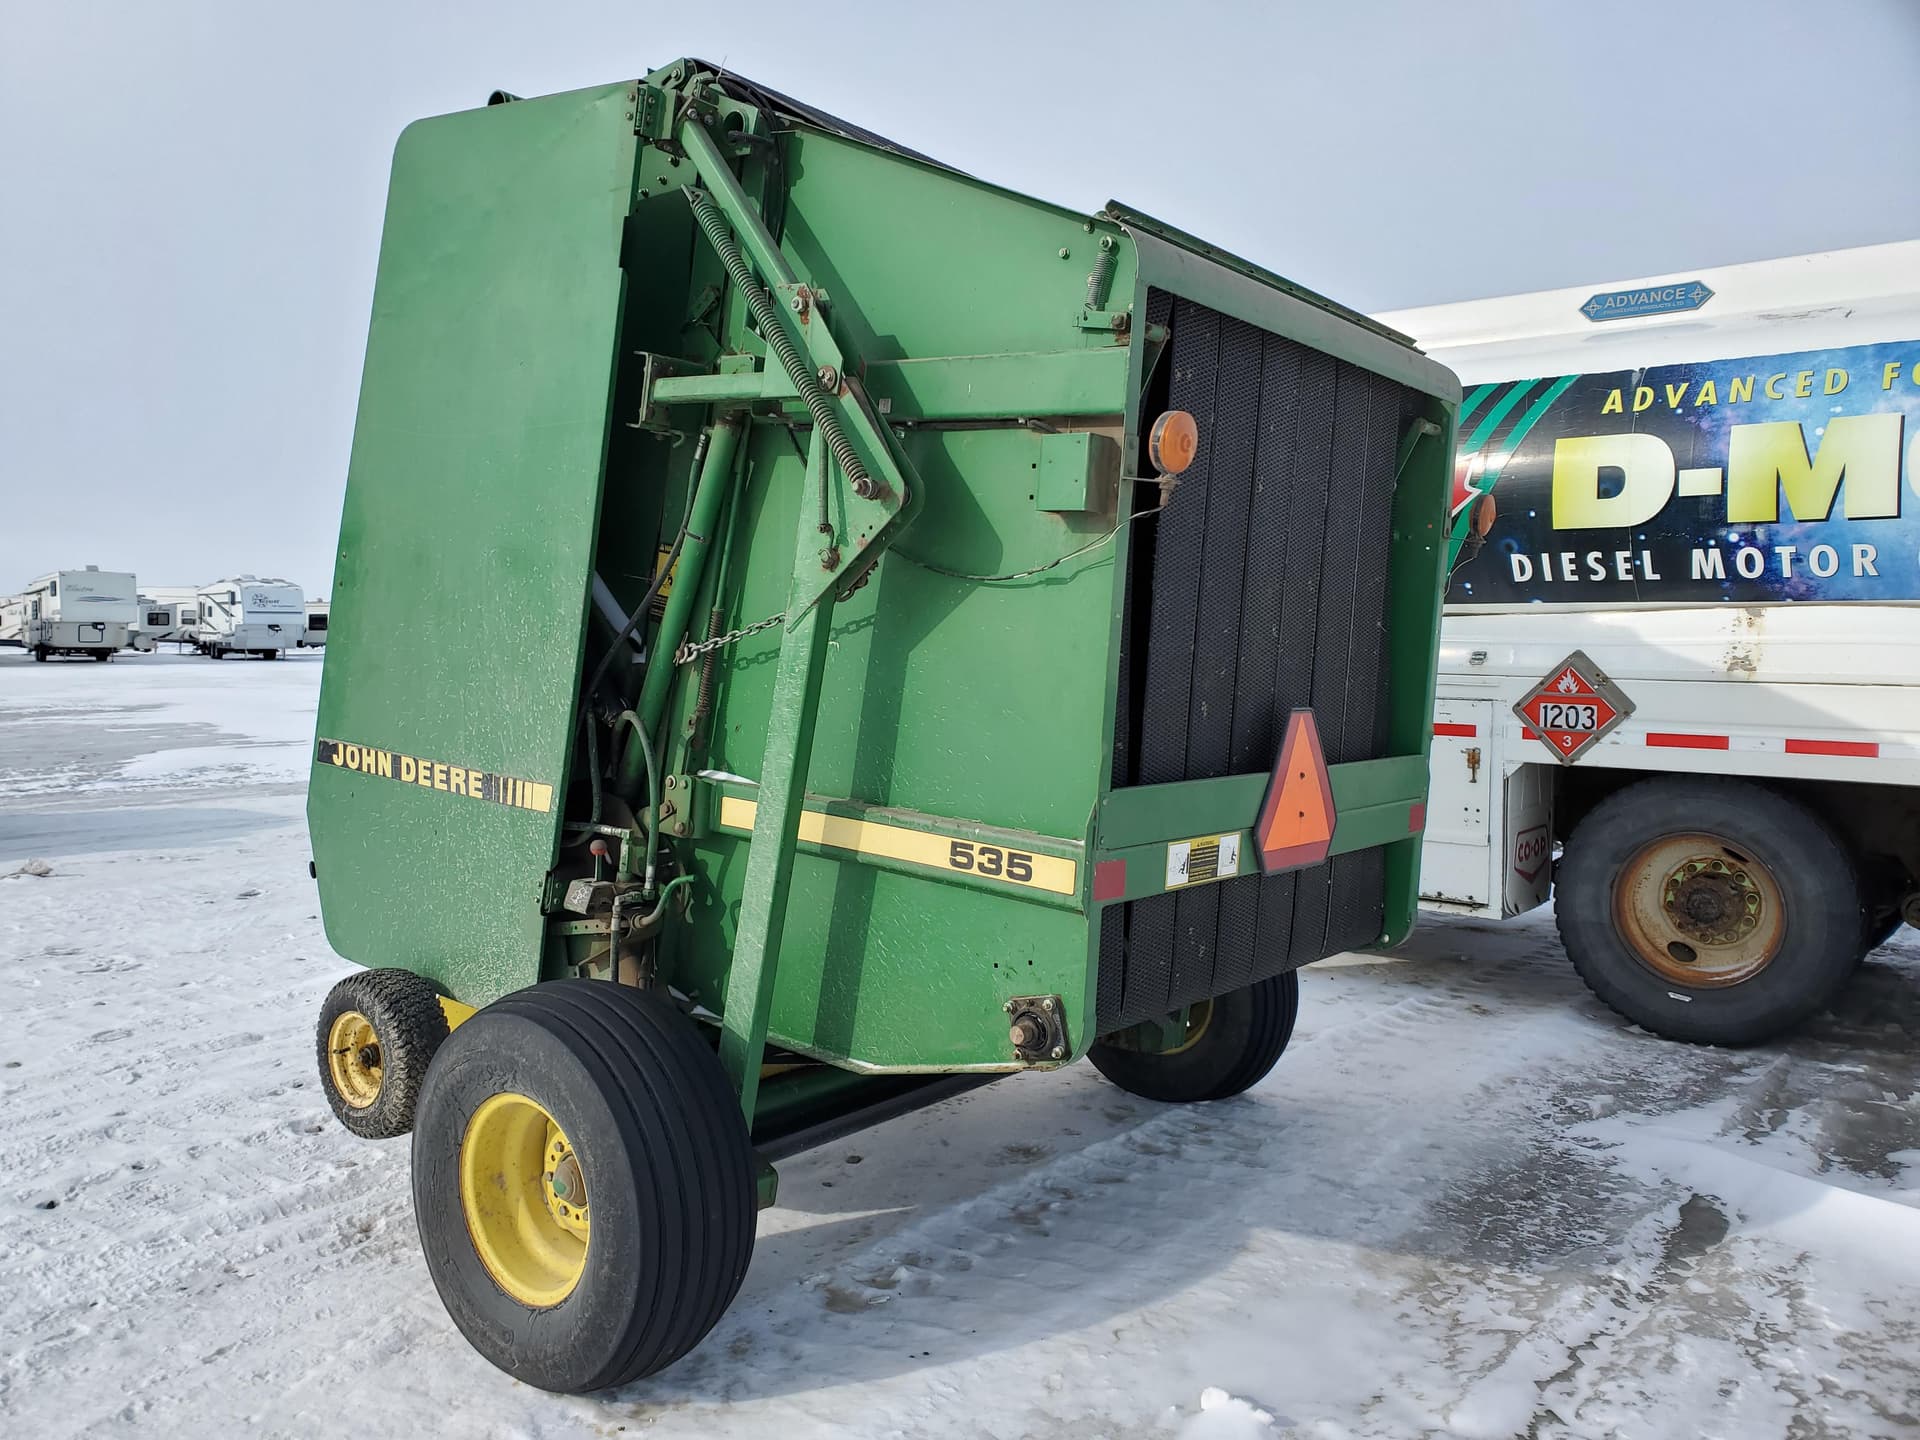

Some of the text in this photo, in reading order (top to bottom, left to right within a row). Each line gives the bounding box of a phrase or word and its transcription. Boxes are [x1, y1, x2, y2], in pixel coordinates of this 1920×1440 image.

[1604, 287, 1686, 309] ADVANCE
[1601, 368, 1850, 415] ADVANCED
[1552, 412, 1920, 530] D-M
[1510, 543, 1880, 583] DIESEL MOTOR
[1542, 704, 1596, 730] 1203
[1562, 735, 1572, 747] 3
[332, 743, 483, 799] JOHN DEERE
[949, 840, 1033, 882] 535
